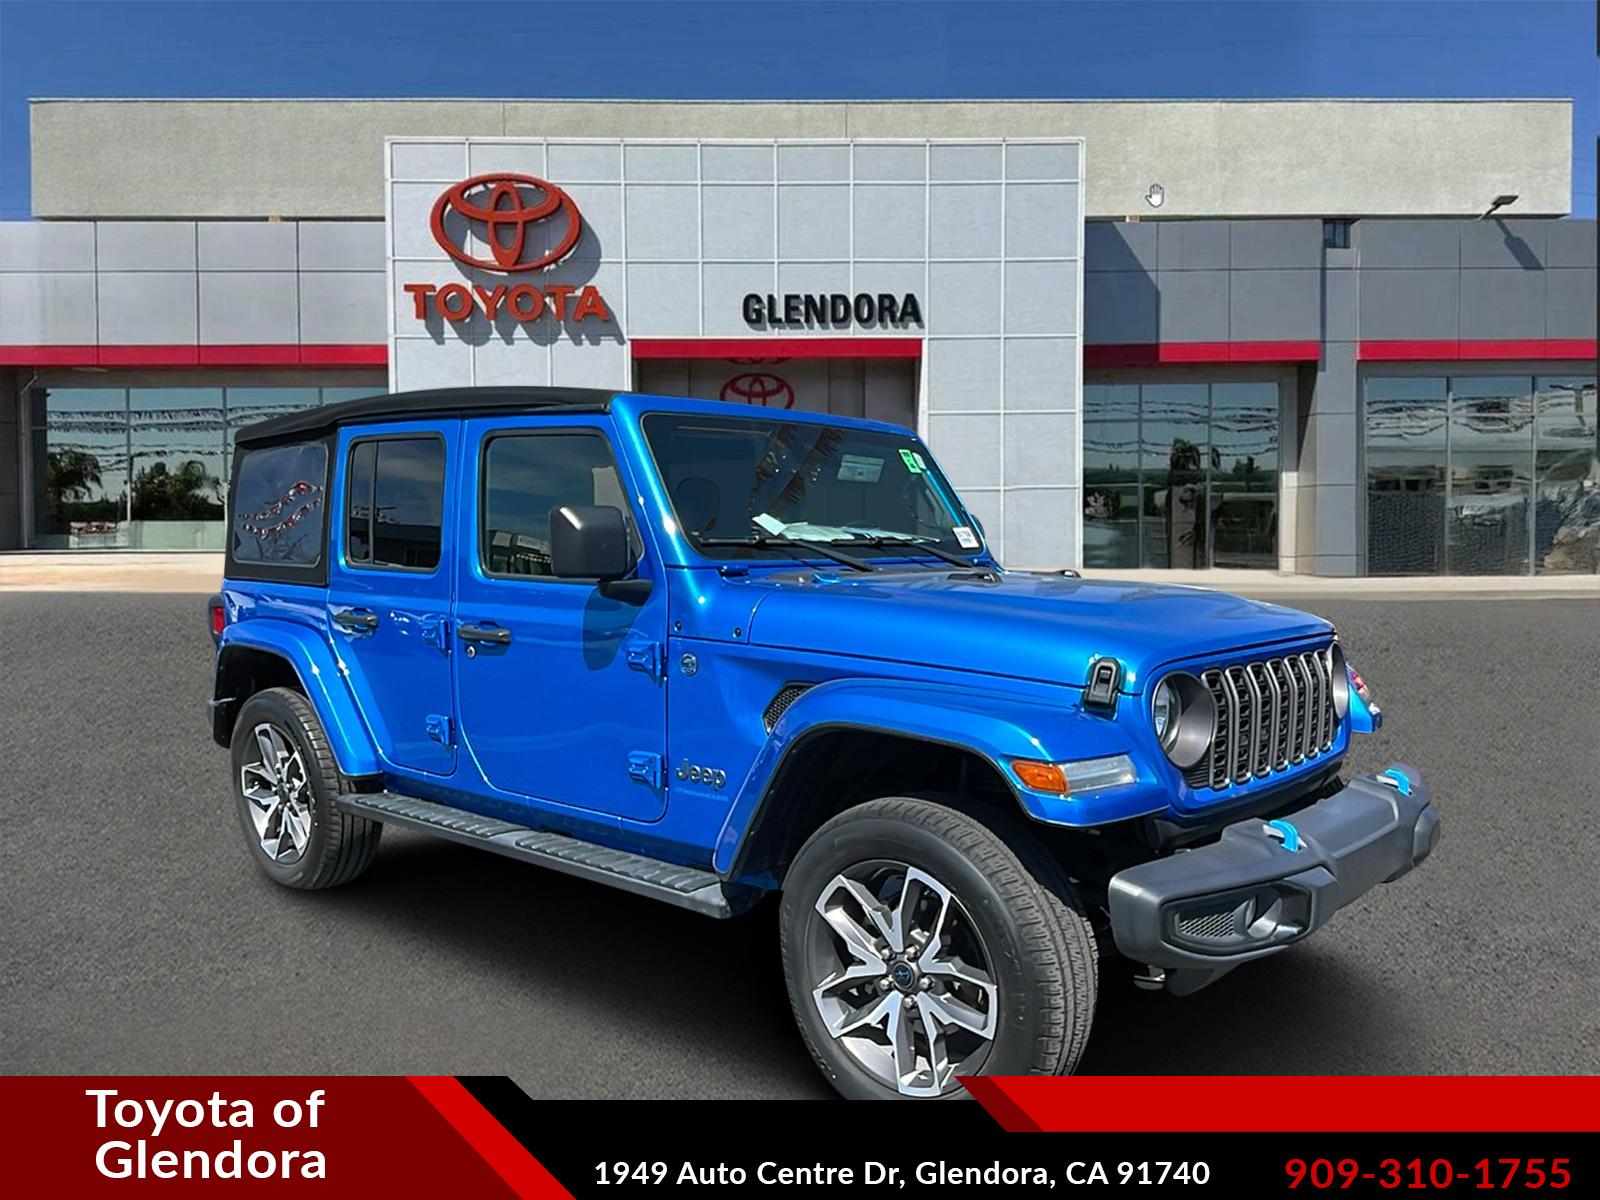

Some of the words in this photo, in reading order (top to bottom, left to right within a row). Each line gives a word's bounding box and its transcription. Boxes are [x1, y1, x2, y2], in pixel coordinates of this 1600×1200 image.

[404, 283, 609, 322] TOYOTA
[742, 293, 923, 325] GLENDORA
[675, 758, 726, 791] Jeep
